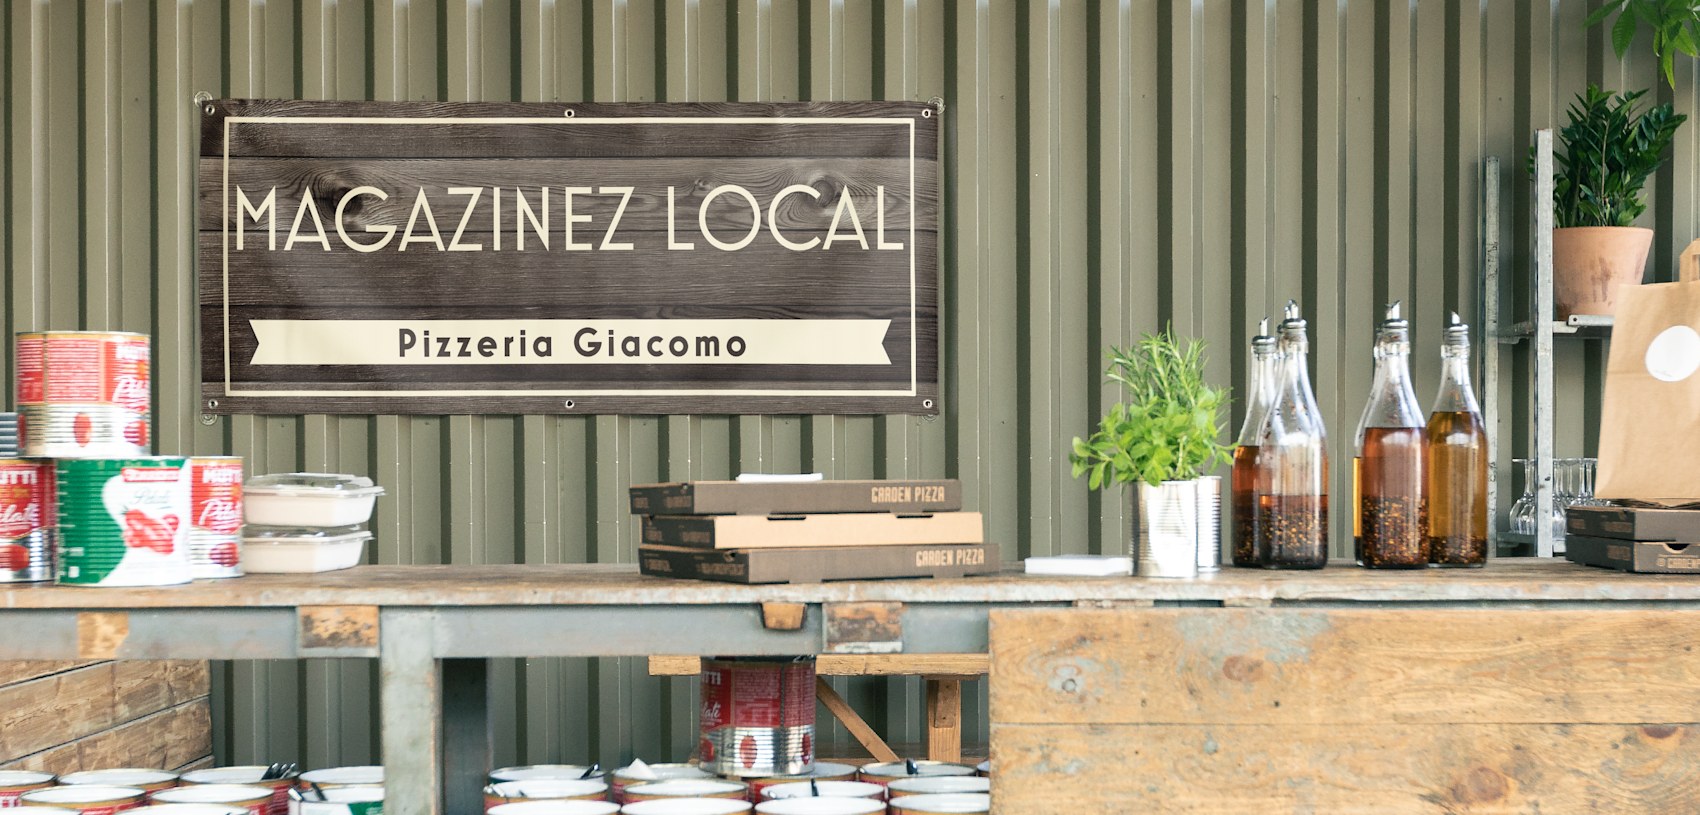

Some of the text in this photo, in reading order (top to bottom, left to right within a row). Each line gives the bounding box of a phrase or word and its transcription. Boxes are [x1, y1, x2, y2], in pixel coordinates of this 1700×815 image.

[236, 184, 904, 252] MAGAZINEZ LOCAL
[398, 326, 748, 358] Pizzeria Giacomo
[871, 485, 946, 503] GARDEN PIZZA
[915, 548, 985, 567] GARDEN PIZZA
